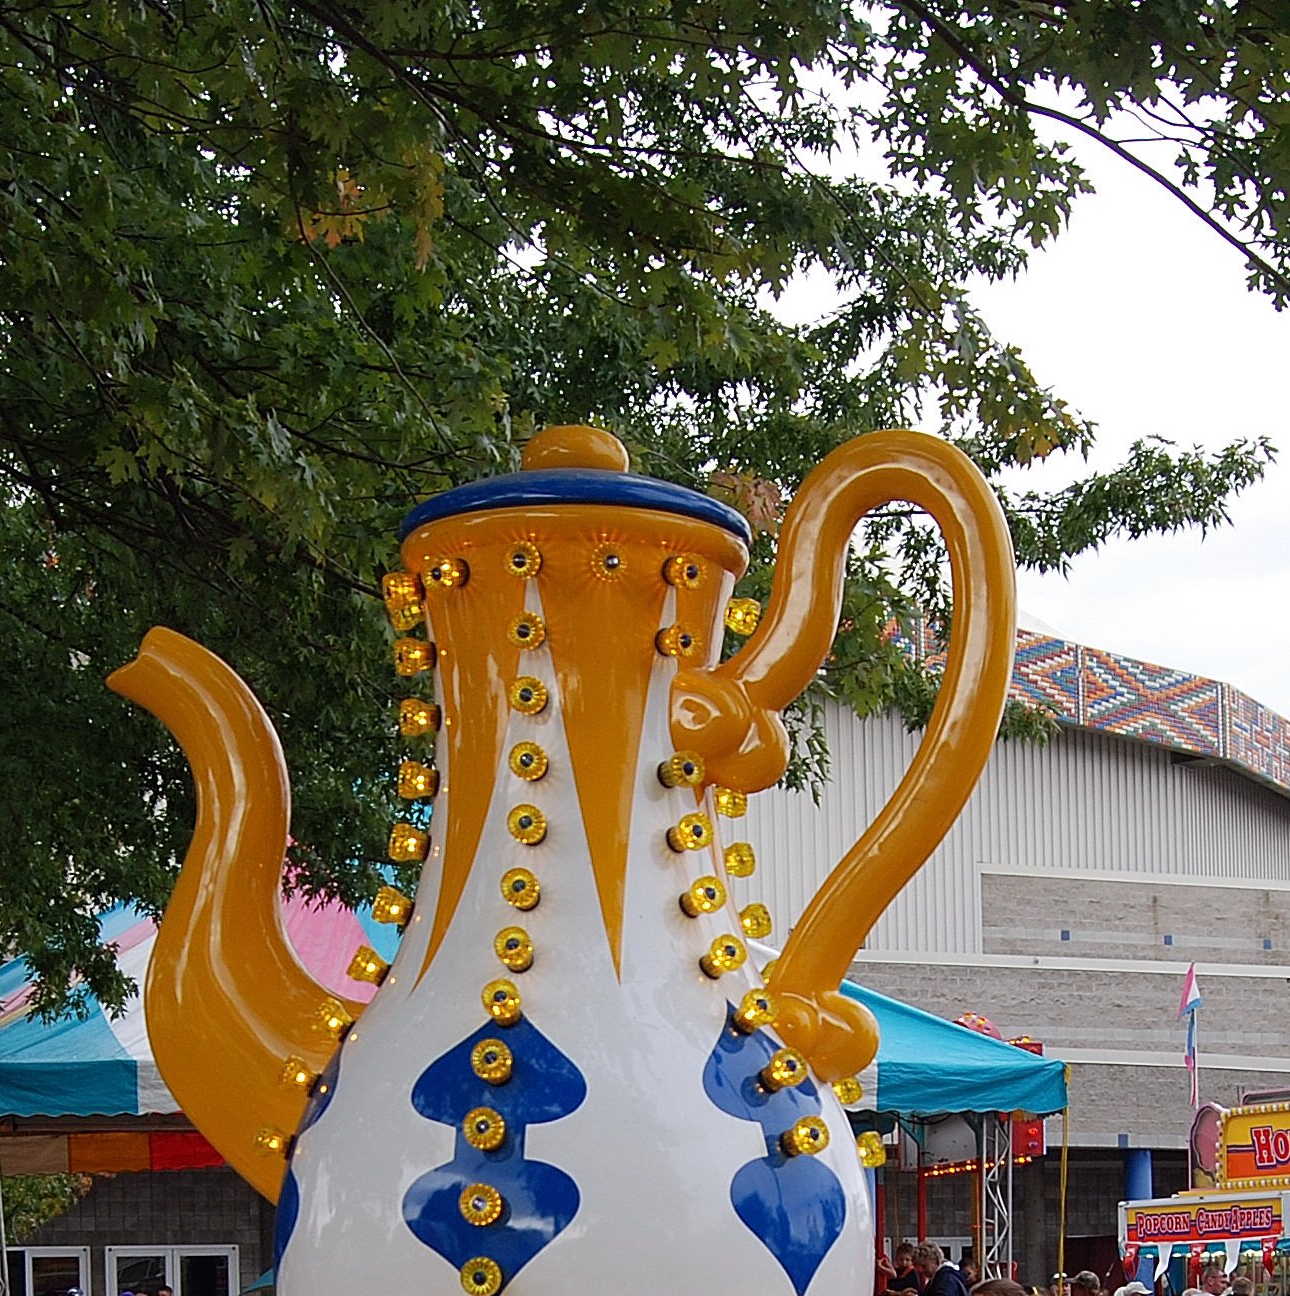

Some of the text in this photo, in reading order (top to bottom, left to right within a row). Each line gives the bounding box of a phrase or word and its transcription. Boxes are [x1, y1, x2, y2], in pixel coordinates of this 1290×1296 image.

[1136, 1206, 1273, 1238] POPCORN CANDY APPLES
